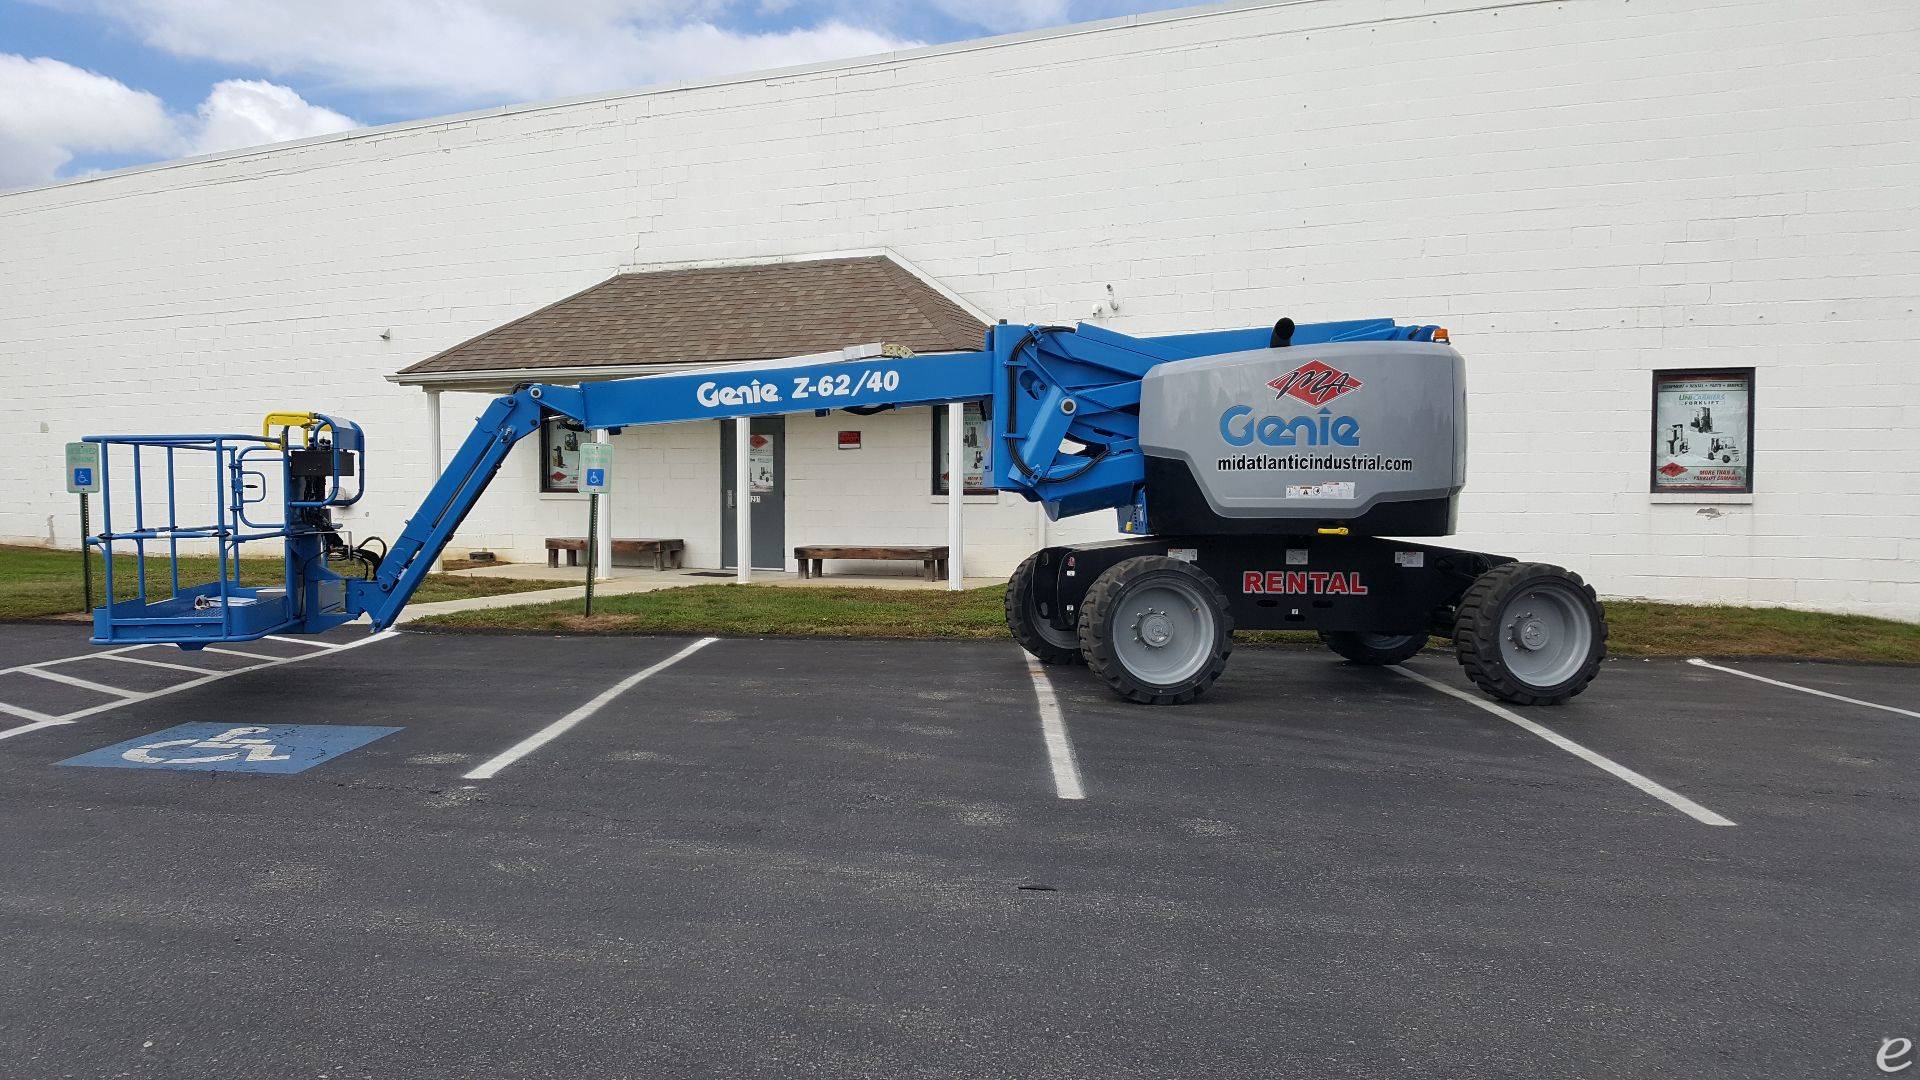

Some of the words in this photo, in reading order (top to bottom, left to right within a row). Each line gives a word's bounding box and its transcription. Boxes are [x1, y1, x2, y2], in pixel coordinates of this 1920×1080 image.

[697, 379, 778, 407] Genie
[792, 370, 899, 399] Z-62/40
[1219, 405, 1360, 446] Genie
[1217, 454, 1412, 471] midatlanticindustrial.com
[1242, 571, 1368, 595] RENTAL
